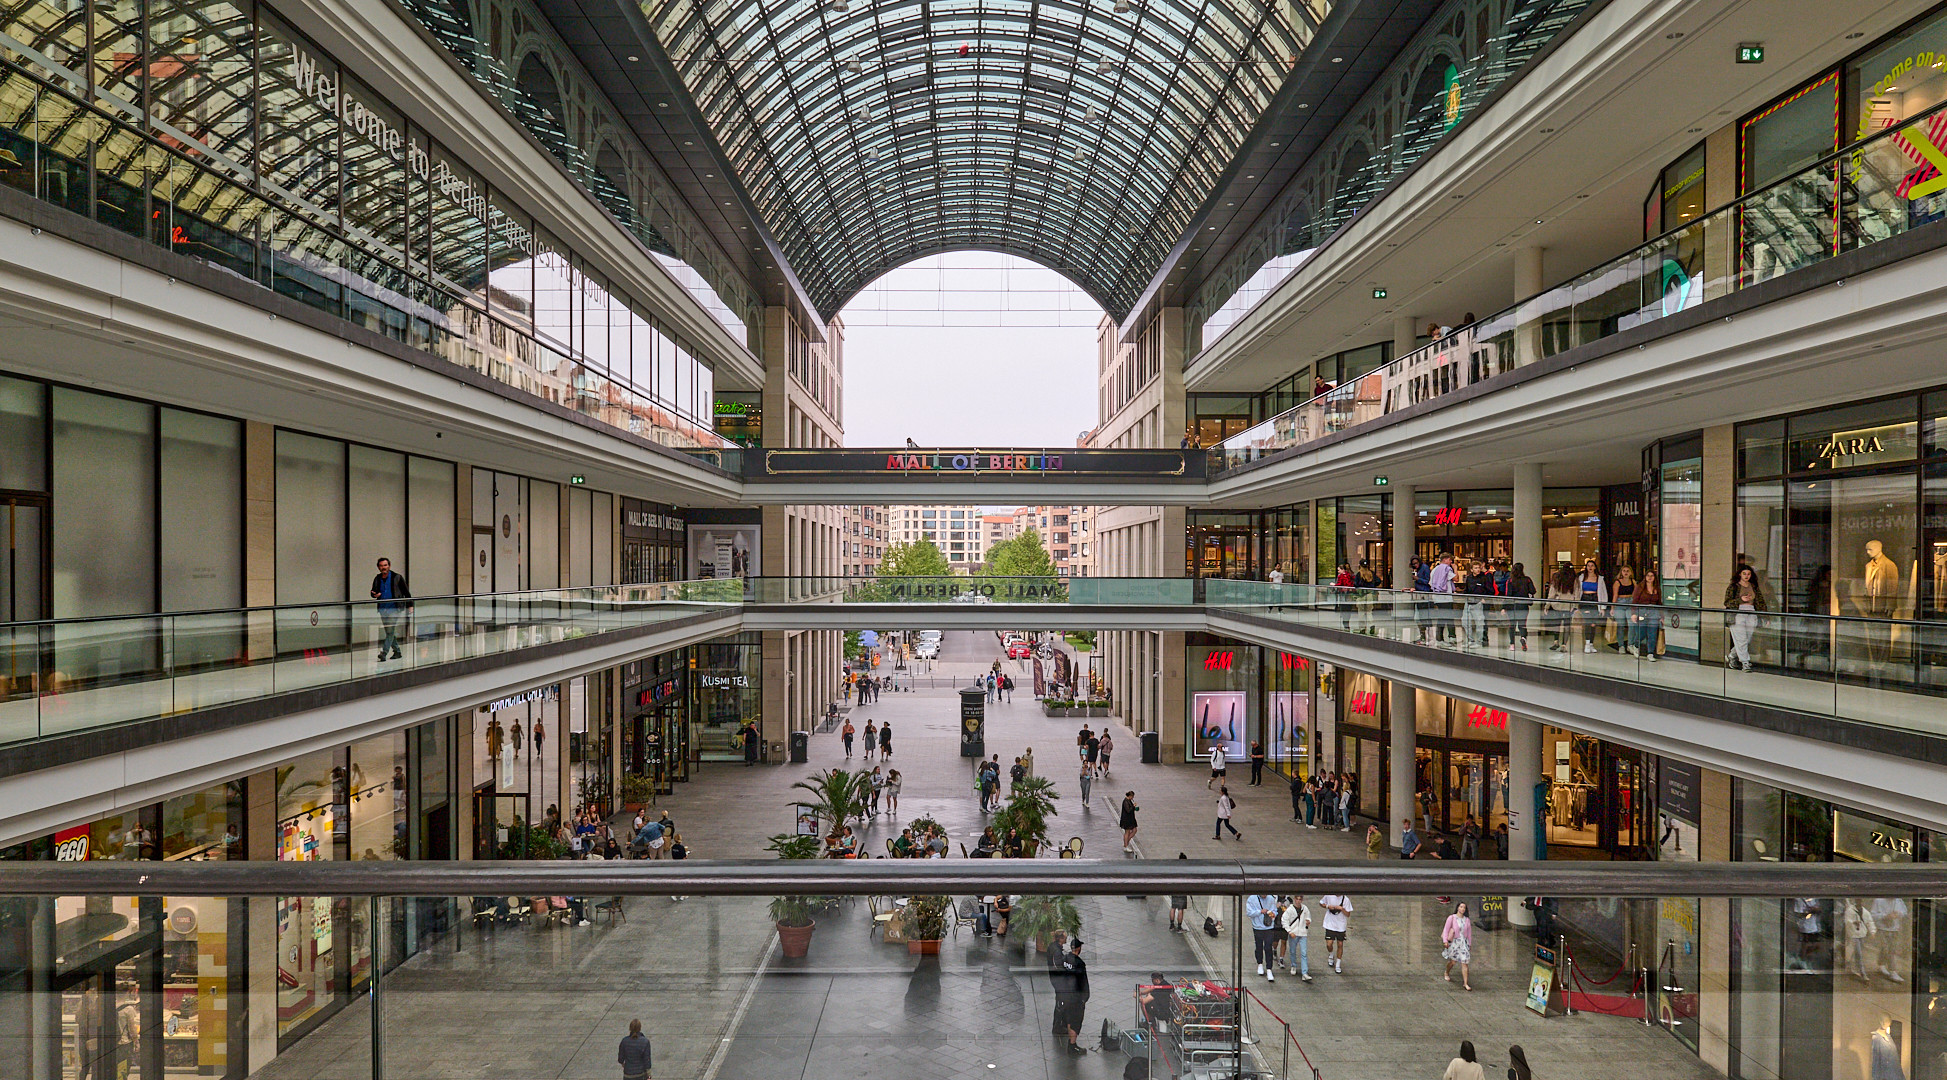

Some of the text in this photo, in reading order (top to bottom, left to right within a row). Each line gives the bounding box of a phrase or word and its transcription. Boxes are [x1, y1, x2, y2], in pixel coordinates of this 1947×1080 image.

[1874, 56, 1913, 98] Come
[1916, 51, 1934, 67] on
[292, 42, 400, 161] Welcome
[409, 137, 430, 181] to
[440, 160, 498, 229] Berlin's
[505, 216, 555, 272] greatest
[1817, 437, 1885, 459] ZARA
[887, 454, 1063, 470] MALL OF BERLIN
[1434, 507, 1463, 526] H&M
[1614, 501, 1640, 517] MALL
[628, 511, 641, 527] MALL
[641, 512, 648, 527] OF
[1204, 651, 1233, 671] H&M
[702, 674, 749, 688] KUSMI TEA
[641, 689, 655, 706] MALL
[1351, 690, 1377, 717] H&M
[1467, 704, 1508, 730] H&M
[1869, 831, 1912, 856] ZAR
[1482, 903, 1503, 911] GYM
